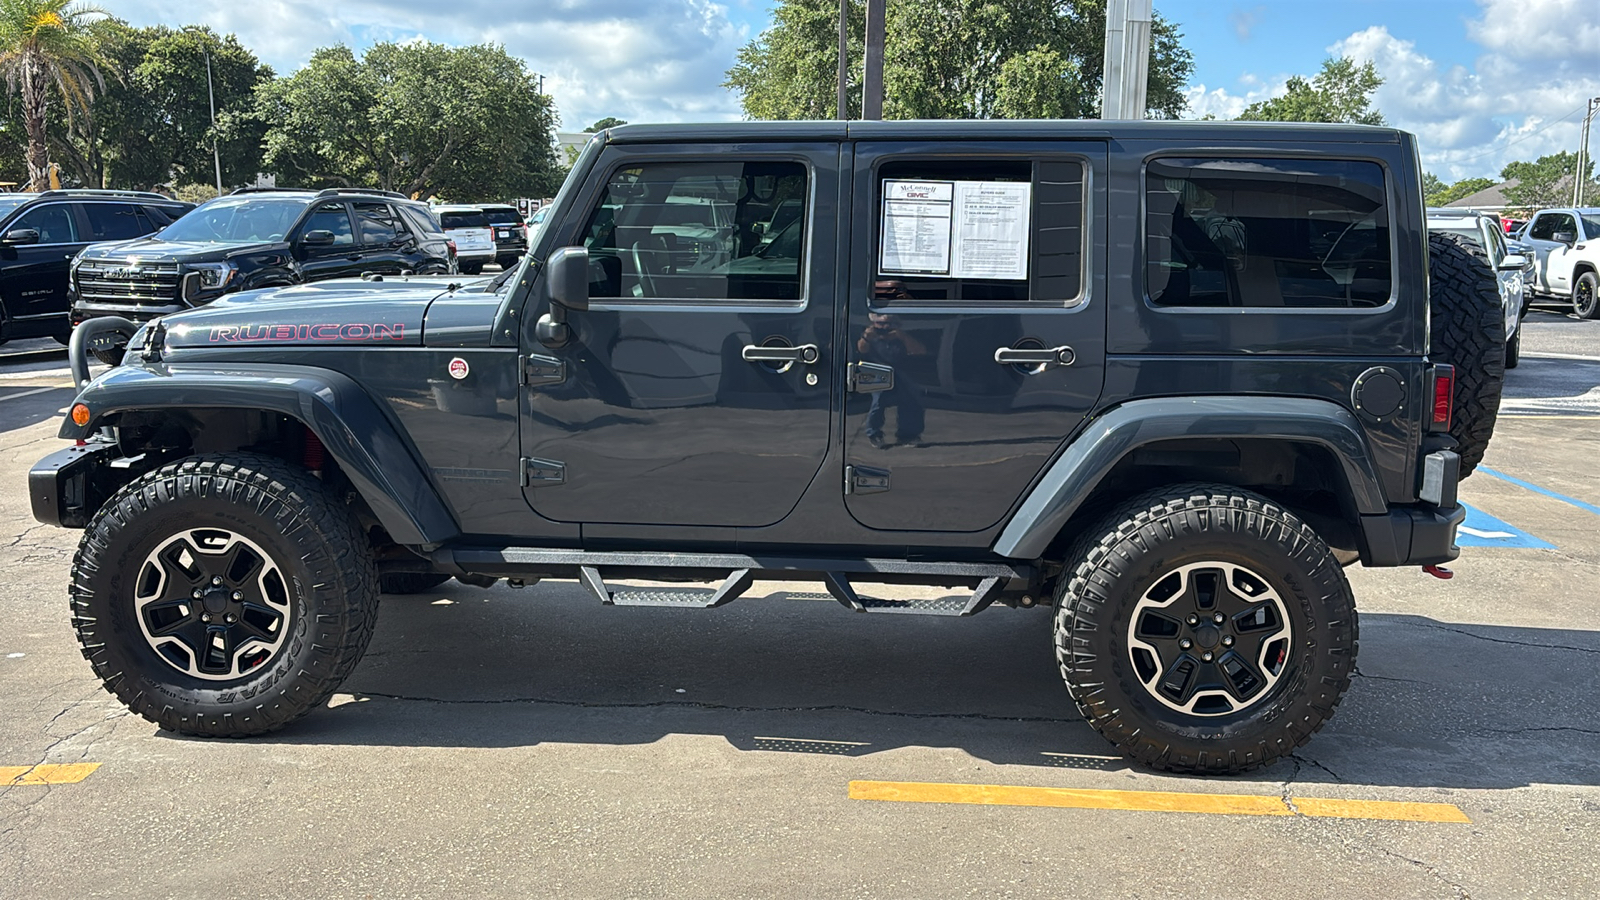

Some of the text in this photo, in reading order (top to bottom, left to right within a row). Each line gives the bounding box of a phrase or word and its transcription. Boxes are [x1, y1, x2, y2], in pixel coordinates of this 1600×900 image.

[900, 184, 937, 193] McConnell
[209, 323, 405, 342] RUBICON
[216, 573, 308, 704] GOODYEAR
